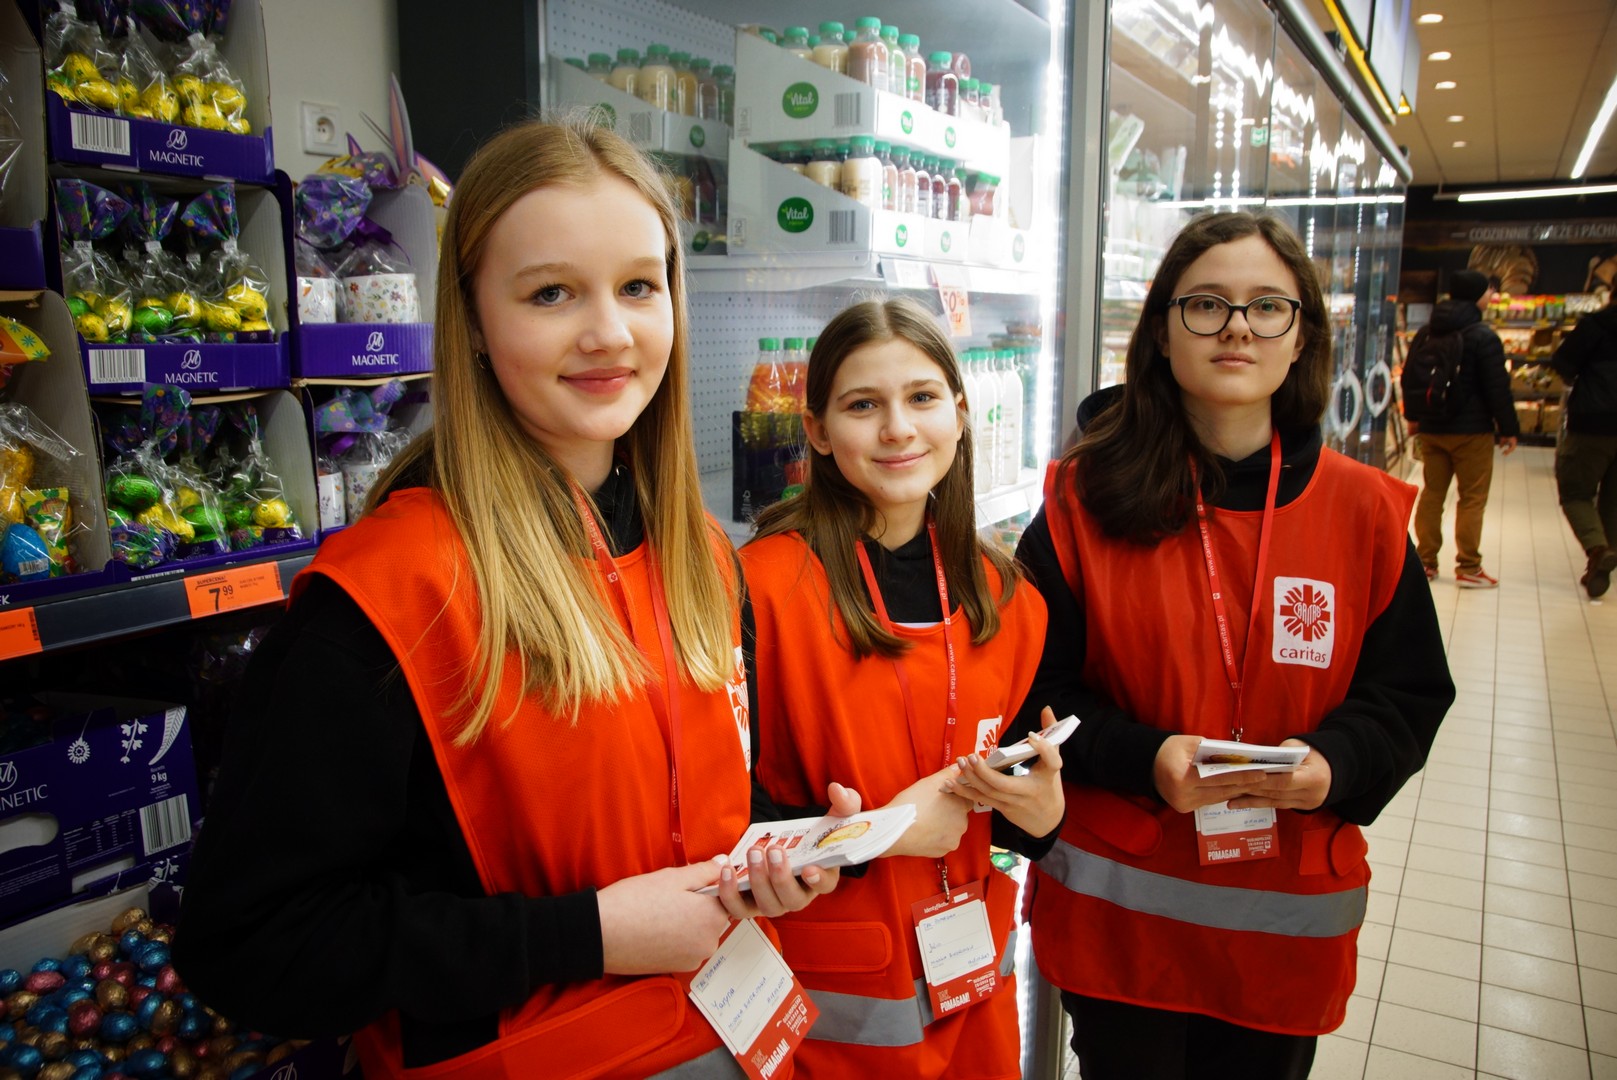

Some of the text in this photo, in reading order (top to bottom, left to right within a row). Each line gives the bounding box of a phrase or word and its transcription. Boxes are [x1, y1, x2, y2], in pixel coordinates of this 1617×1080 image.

[149, 150, 205, 167] MAGNETIC
[786, 206, 809, 220] Vital
[352, 353, 400, 367] MAGNETIC
[164, 371, 219, 384] MAGNETIC
[1217, 614, 1233, 667] www.caritas.pl
[1279, 646, 1327, 664] caritas
[948, 642, 956, 701] www.caritas.pl
[157, 772, 168, 782] kg
[0, 783, 49, 811] NETIC
[1207, 848, 1241, 861] POMAGAM!
[940, 991, 971, 1013] POMAGAM!
[760, 1038, 790, 1080] POMAGAM!
